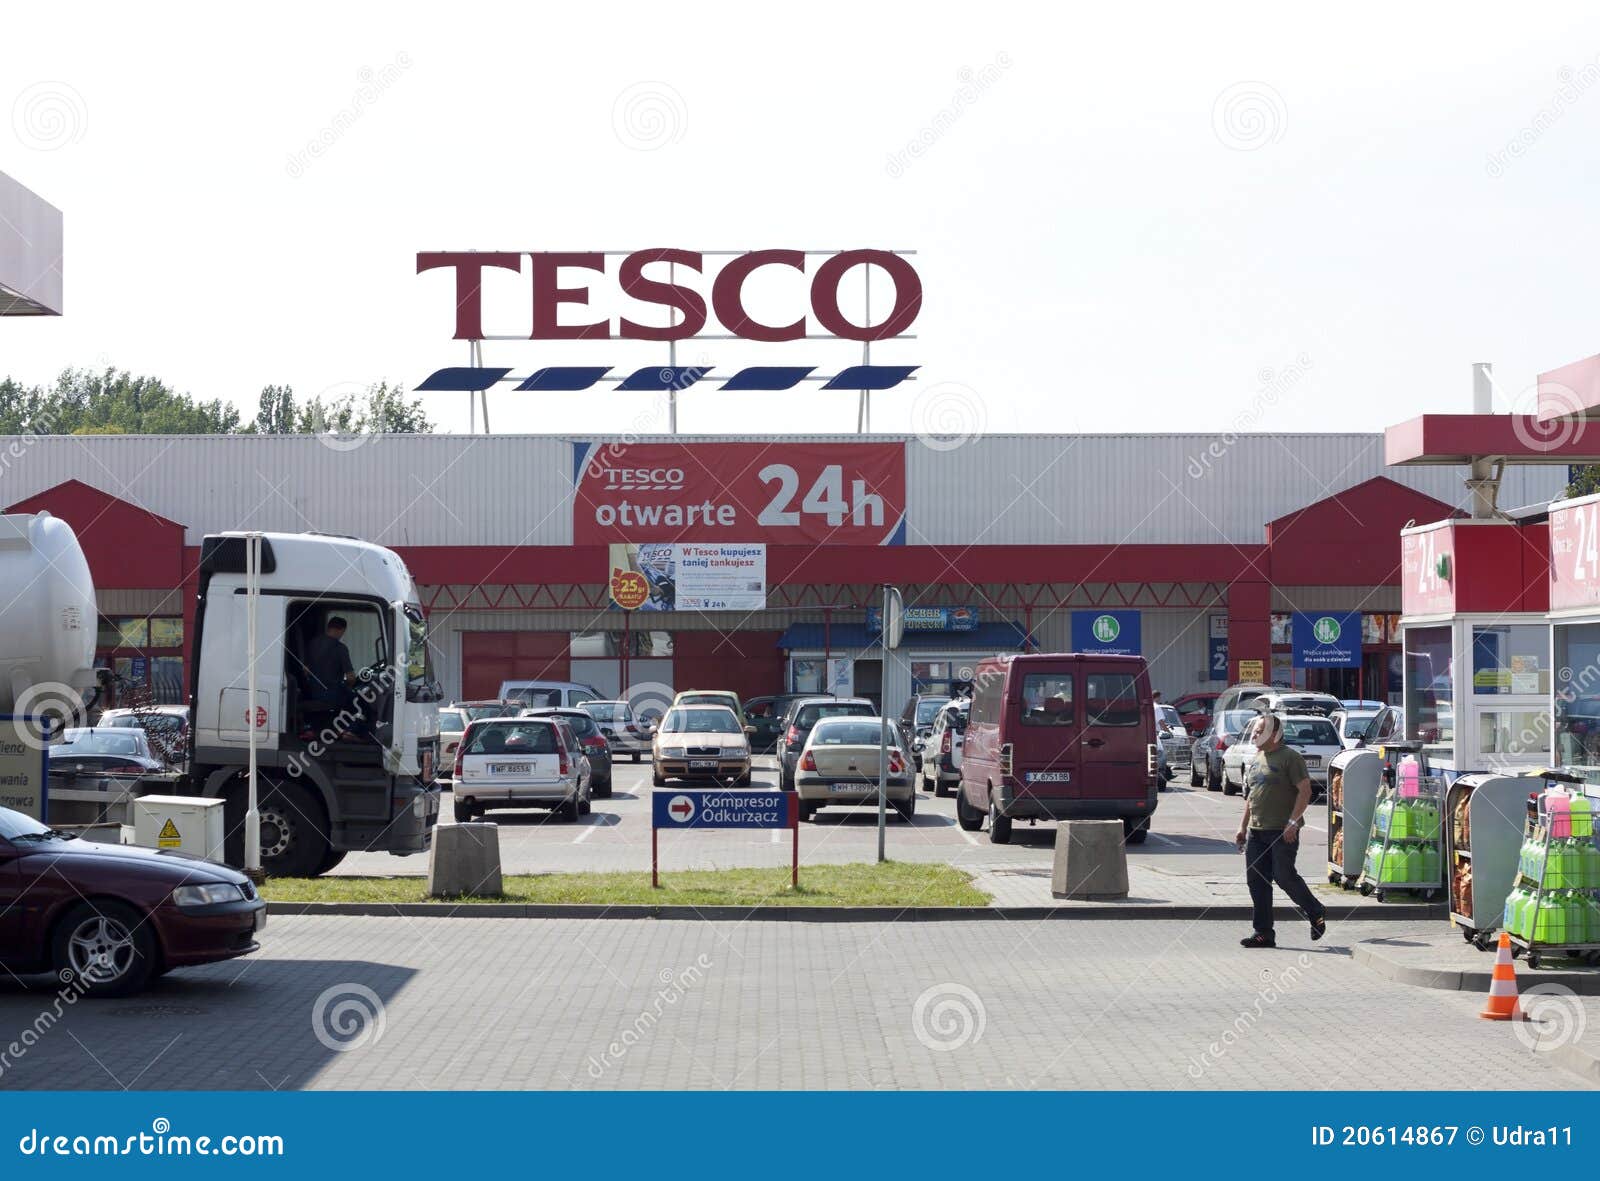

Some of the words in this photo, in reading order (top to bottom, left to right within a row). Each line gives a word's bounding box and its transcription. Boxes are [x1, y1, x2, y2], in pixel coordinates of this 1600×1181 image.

[416, 247, 923, 342] TESCO
[603, 468, 684, 484] TESCO
[757, 463, 885, 527] 24h
[595, 500, 736, 527] otwarte
[682, 548, 691, 556] W
[694, 548, 719, 556] Tesco
[720, 548, 762, 558] kupujesz
[682, 559, 708, 568] taniej
[710, 558, 755, 568] tankujesz
[702, 795, 779, 809] Kompresor
[702, 809, 778, 823] Odkurzacz
